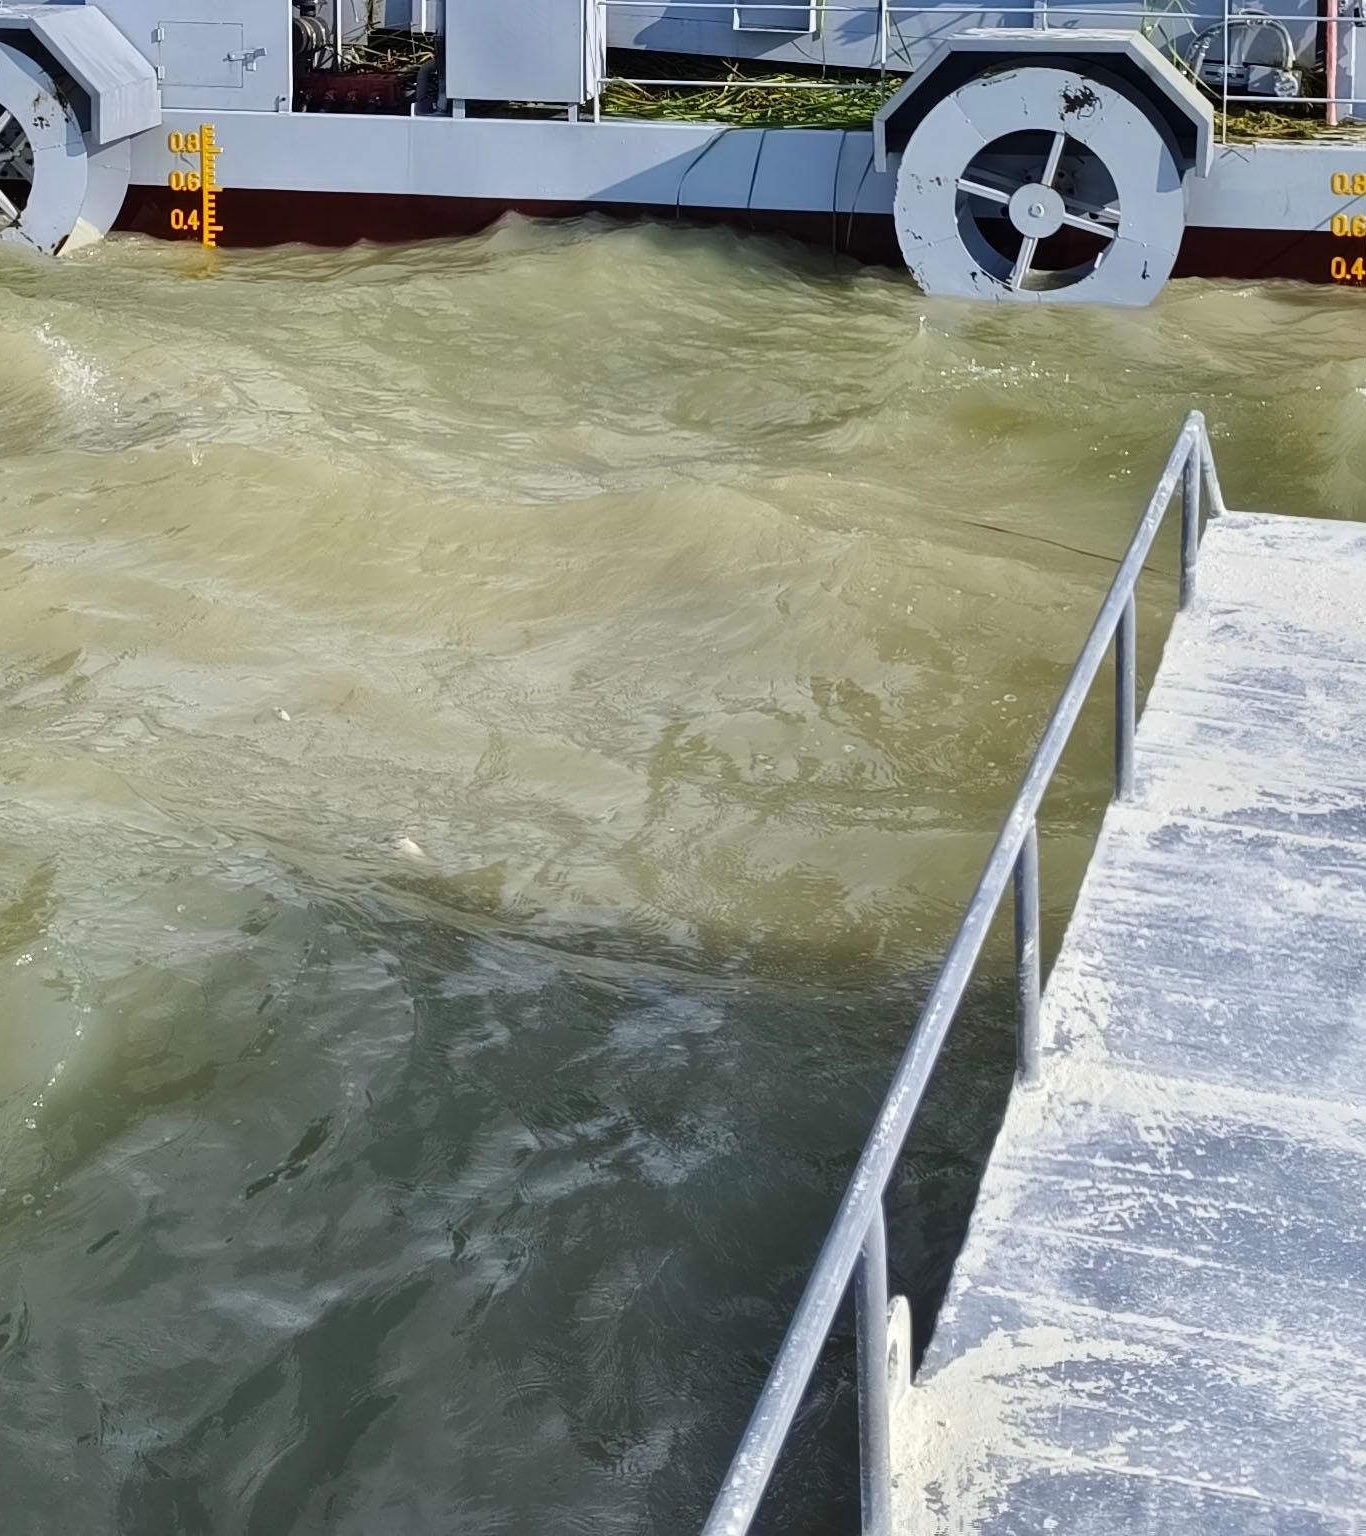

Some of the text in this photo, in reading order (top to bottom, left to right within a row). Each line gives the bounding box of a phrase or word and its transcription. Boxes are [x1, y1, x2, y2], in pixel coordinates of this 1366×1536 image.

[169, 131, 200, 153] 0.8
[169, 170, 201, 192] 0.6
[170, 208, 200, 231] 0.4
[1331, 256, 1366, 280] 0.4
